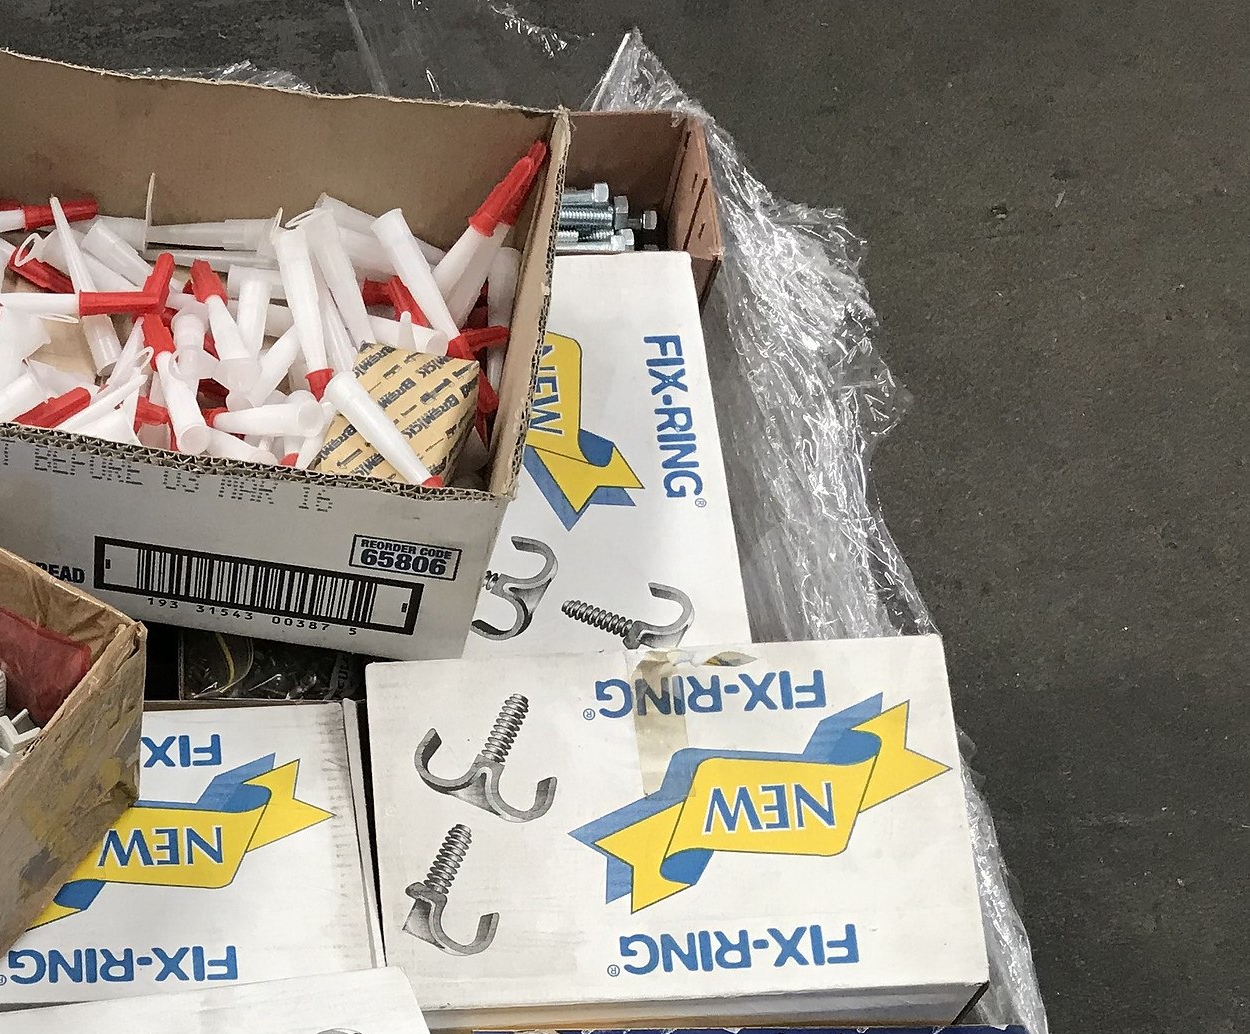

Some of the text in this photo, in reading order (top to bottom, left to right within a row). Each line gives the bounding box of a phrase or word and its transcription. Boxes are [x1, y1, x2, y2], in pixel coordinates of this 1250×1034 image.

[643, 335, 703, 498] FIX-RING
[359, 549, 448, 576] 65806
[360, 538, 452, 560] REORDER CODE
[195, 604, 254, 621] 31543
[271, 614, 331, 631] 00387
[349, 627, 357, 635] 5
[595, 669, 827, 720] FIX-RING
[702, 781, 836, 834] NEW
[97, 825, 223, 867] NEW
[8, 944, 239, 984] FIX-RING
[619, 922, 860, 975] FIX-RING
